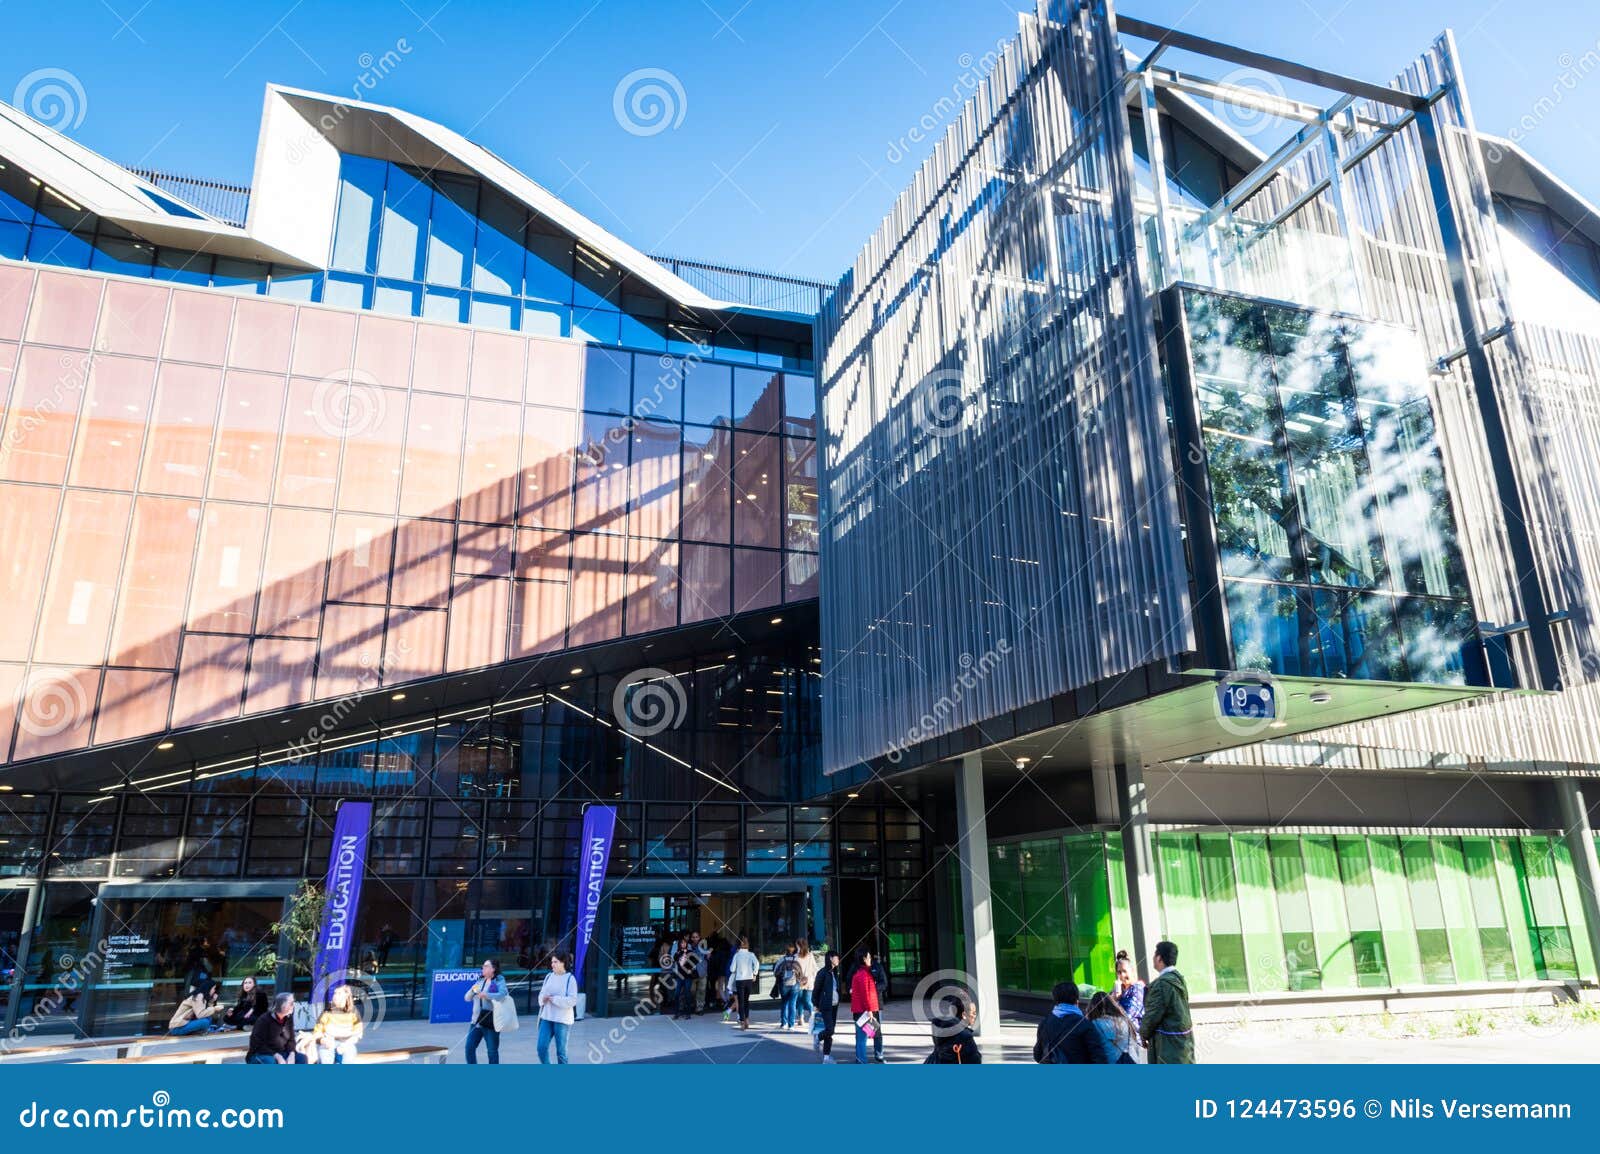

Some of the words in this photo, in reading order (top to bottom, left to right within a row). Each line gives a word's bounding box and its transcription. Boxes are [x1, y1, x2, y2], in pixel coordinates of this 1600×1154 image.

[1226, 687, 1247, 707] 19
[326, 835, 358, 951] EDUCATION
[435, 972, 480, 982] EDUCATION
